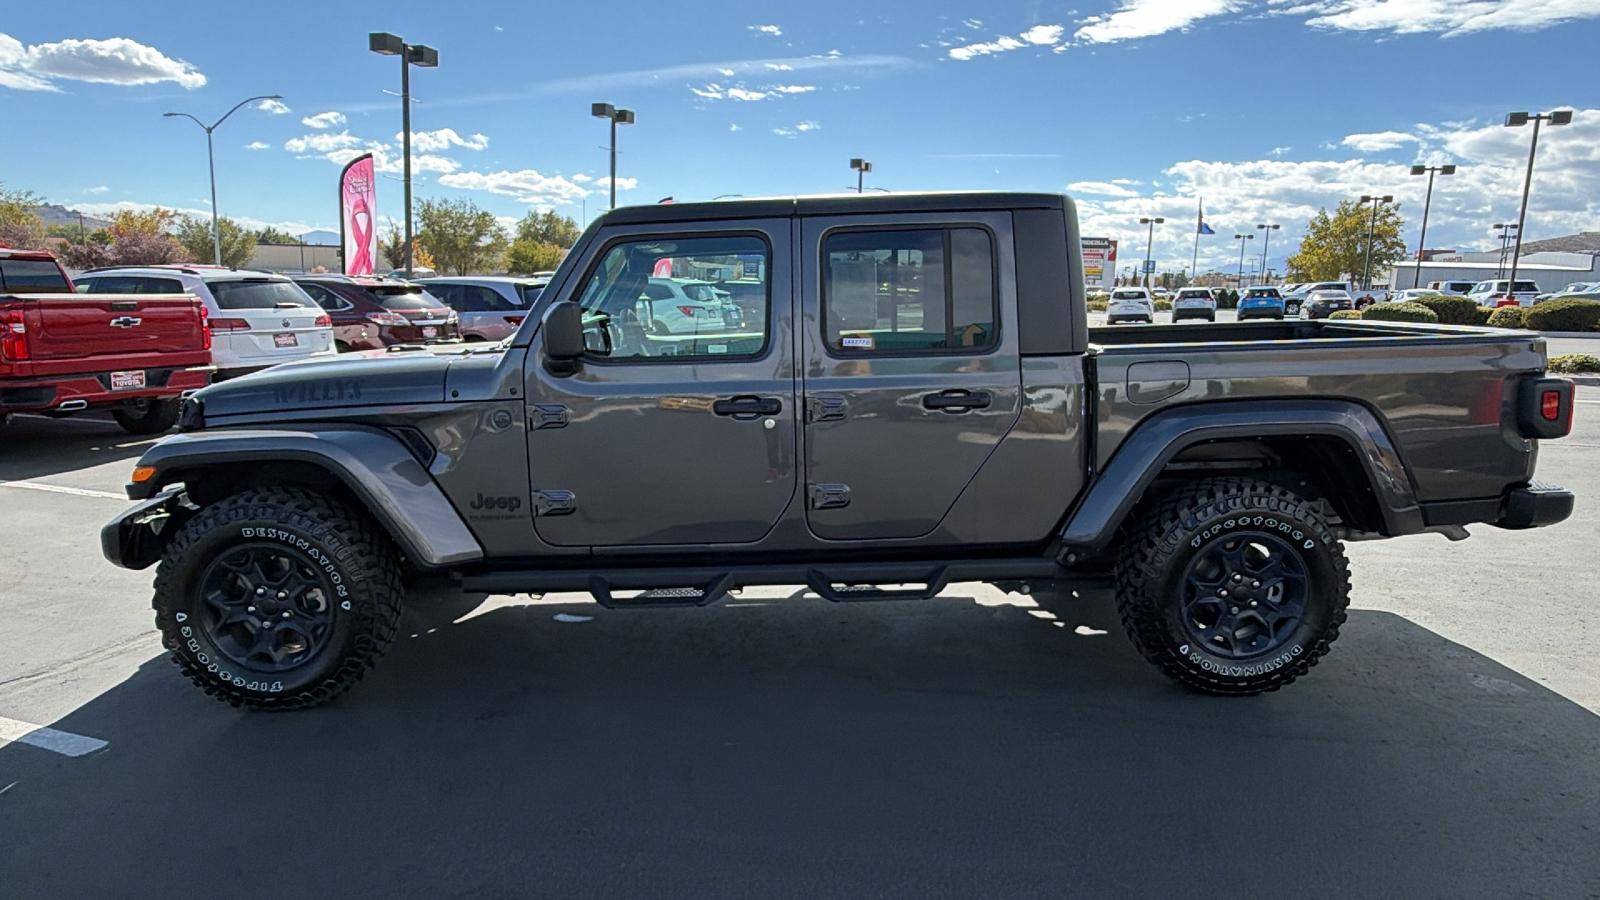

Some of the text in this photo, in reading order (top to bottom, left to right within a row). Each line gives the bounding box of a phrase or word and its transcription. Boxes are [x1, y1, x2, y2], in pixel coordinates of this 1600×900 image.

[115, 379, 140, 387] TOYOTA
[274, 380, 361, 403] WILLYS
[469, 493, 521, 512] Jeep
[241, 527, 348, 598] DESTINATION
[1189, 644, 1304, 677] DESTINATION
